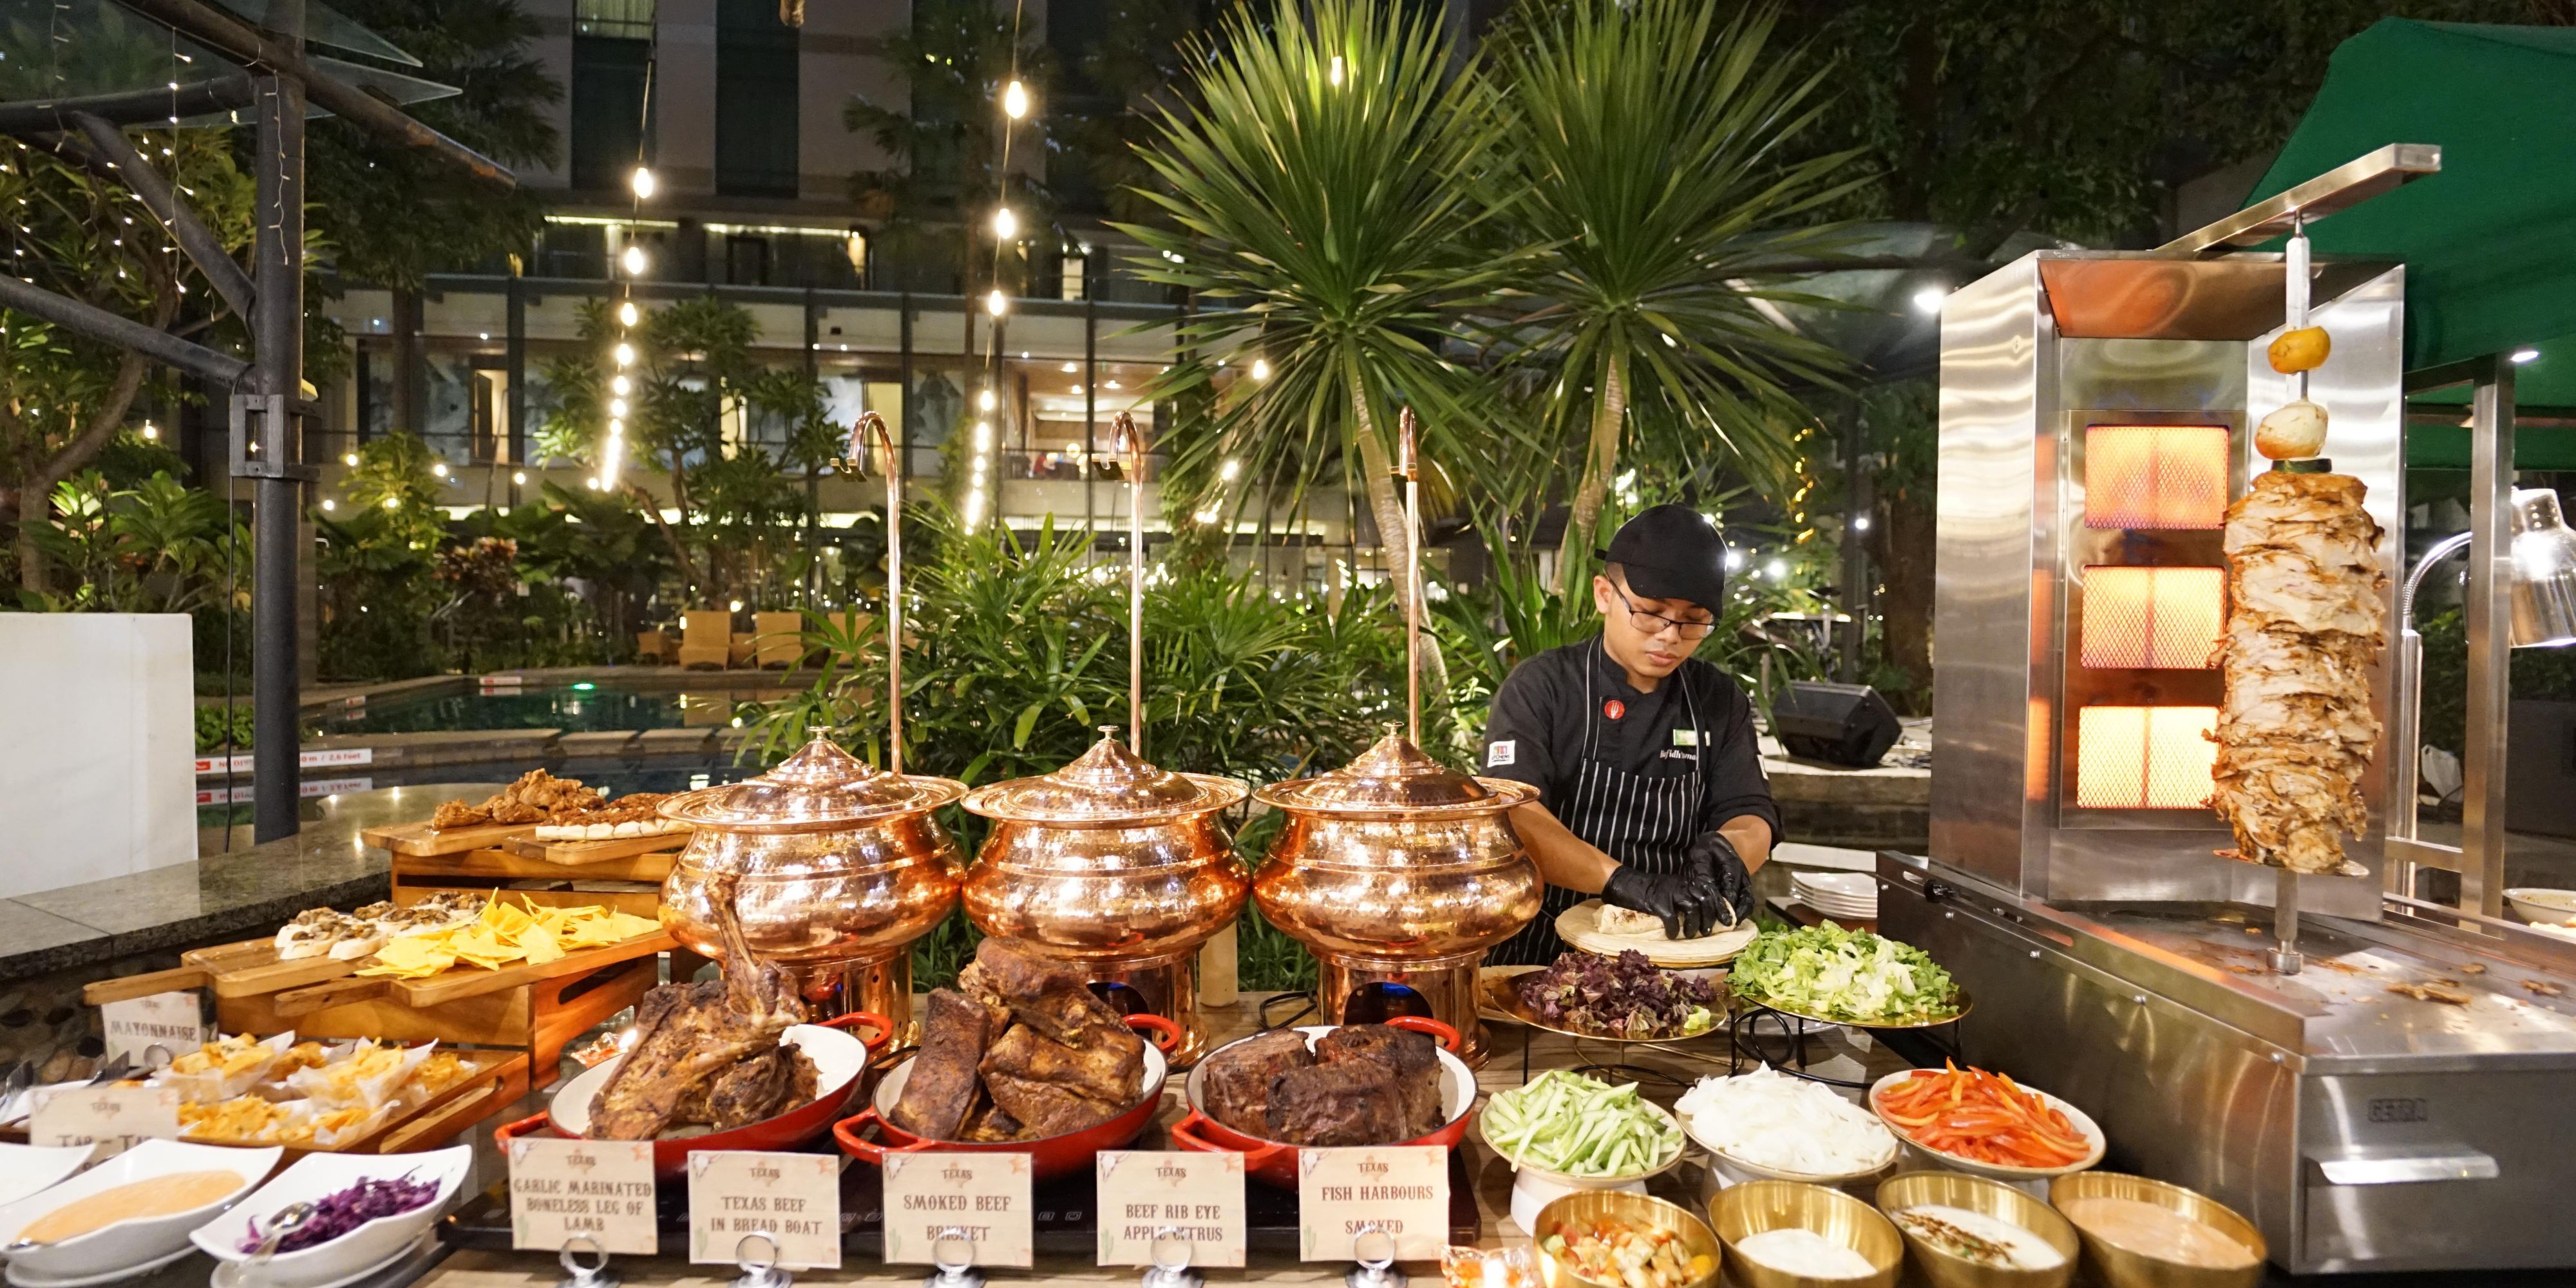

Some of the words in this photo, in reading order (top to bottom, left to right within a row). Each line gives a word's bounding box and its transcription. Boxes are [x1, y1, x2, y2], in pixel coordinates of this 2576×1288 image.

[110, 1021, 196, 1041] MAYONNAISE
[749, 1168, 781, 1179] TEXAS
[942, 1169, 973, 1180] TEXAS
[1155, 1167, 1187, 1179] TEXAS
[1358, 1162, 1389, 1173] TEXAS
[513, 1179, 562, 1193] GARLIC
[567, 1180, 652, 1197] MARINATED
[1321, 1186, 1352, 1201] FISH
[1360, 1186, 1434, 1200] HARBOURS
[526, 1198, 589, 1213] BONELESS
[596, 1200, 620, 1215] LEG
[626, 1201, 644, 1216] OF
[721, 1196, 766, 1211] TEXAS
[773, 1197, 806, 1212] BEEF
[904, 1195, 967, 1211] SMOKED
[976, 1196, 1012, 1211] BEEF
[1126, 1204, 1159, 1218] BEEF
[1165, 1204, 1189, 1219] RIB
[1195, 1205, 1220, 1220] EYE
[564, 1217, 605, 1231] LAMB
[710, 1217, 725, 1231] IN
[733, 1217, 777, 1233] BREAD
[785, 1220, 823, 1235] BOAT
[1345, 1220, 1403, 1235] SMOKED
